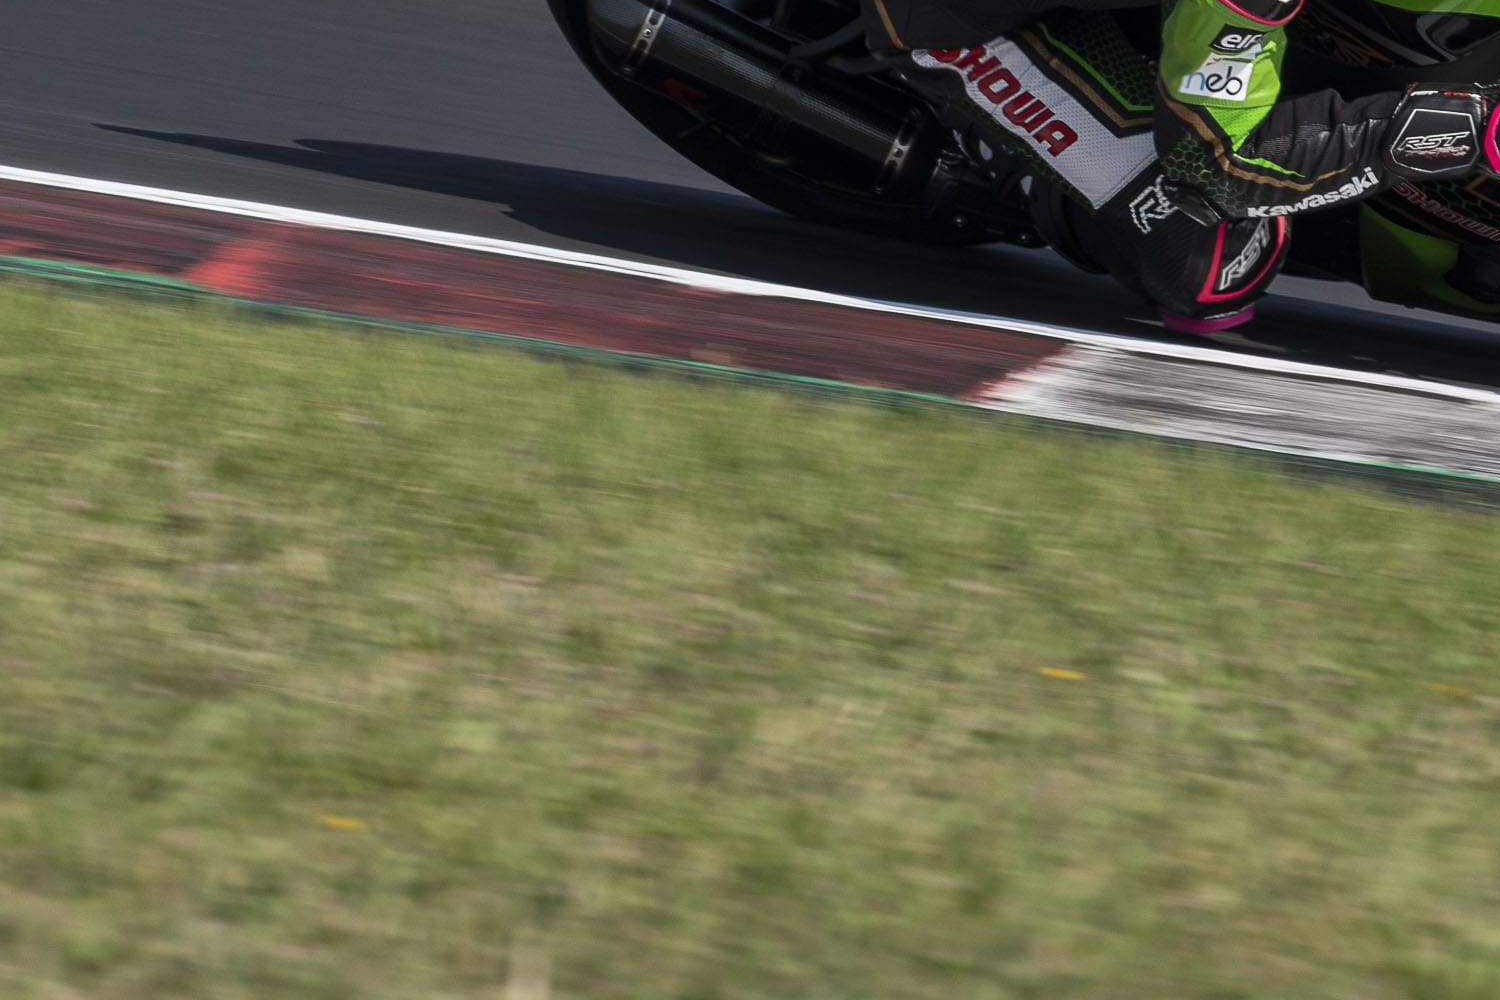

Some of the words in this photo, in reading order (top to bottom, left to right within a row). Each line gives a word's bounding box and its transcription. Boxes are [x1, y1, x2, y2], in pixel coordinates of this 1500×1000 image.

[1221, 32, 1265, 50] elf
[1393, 130, 1472, 153] RST
[1247, 166, 1380, 219] Kawasaki
